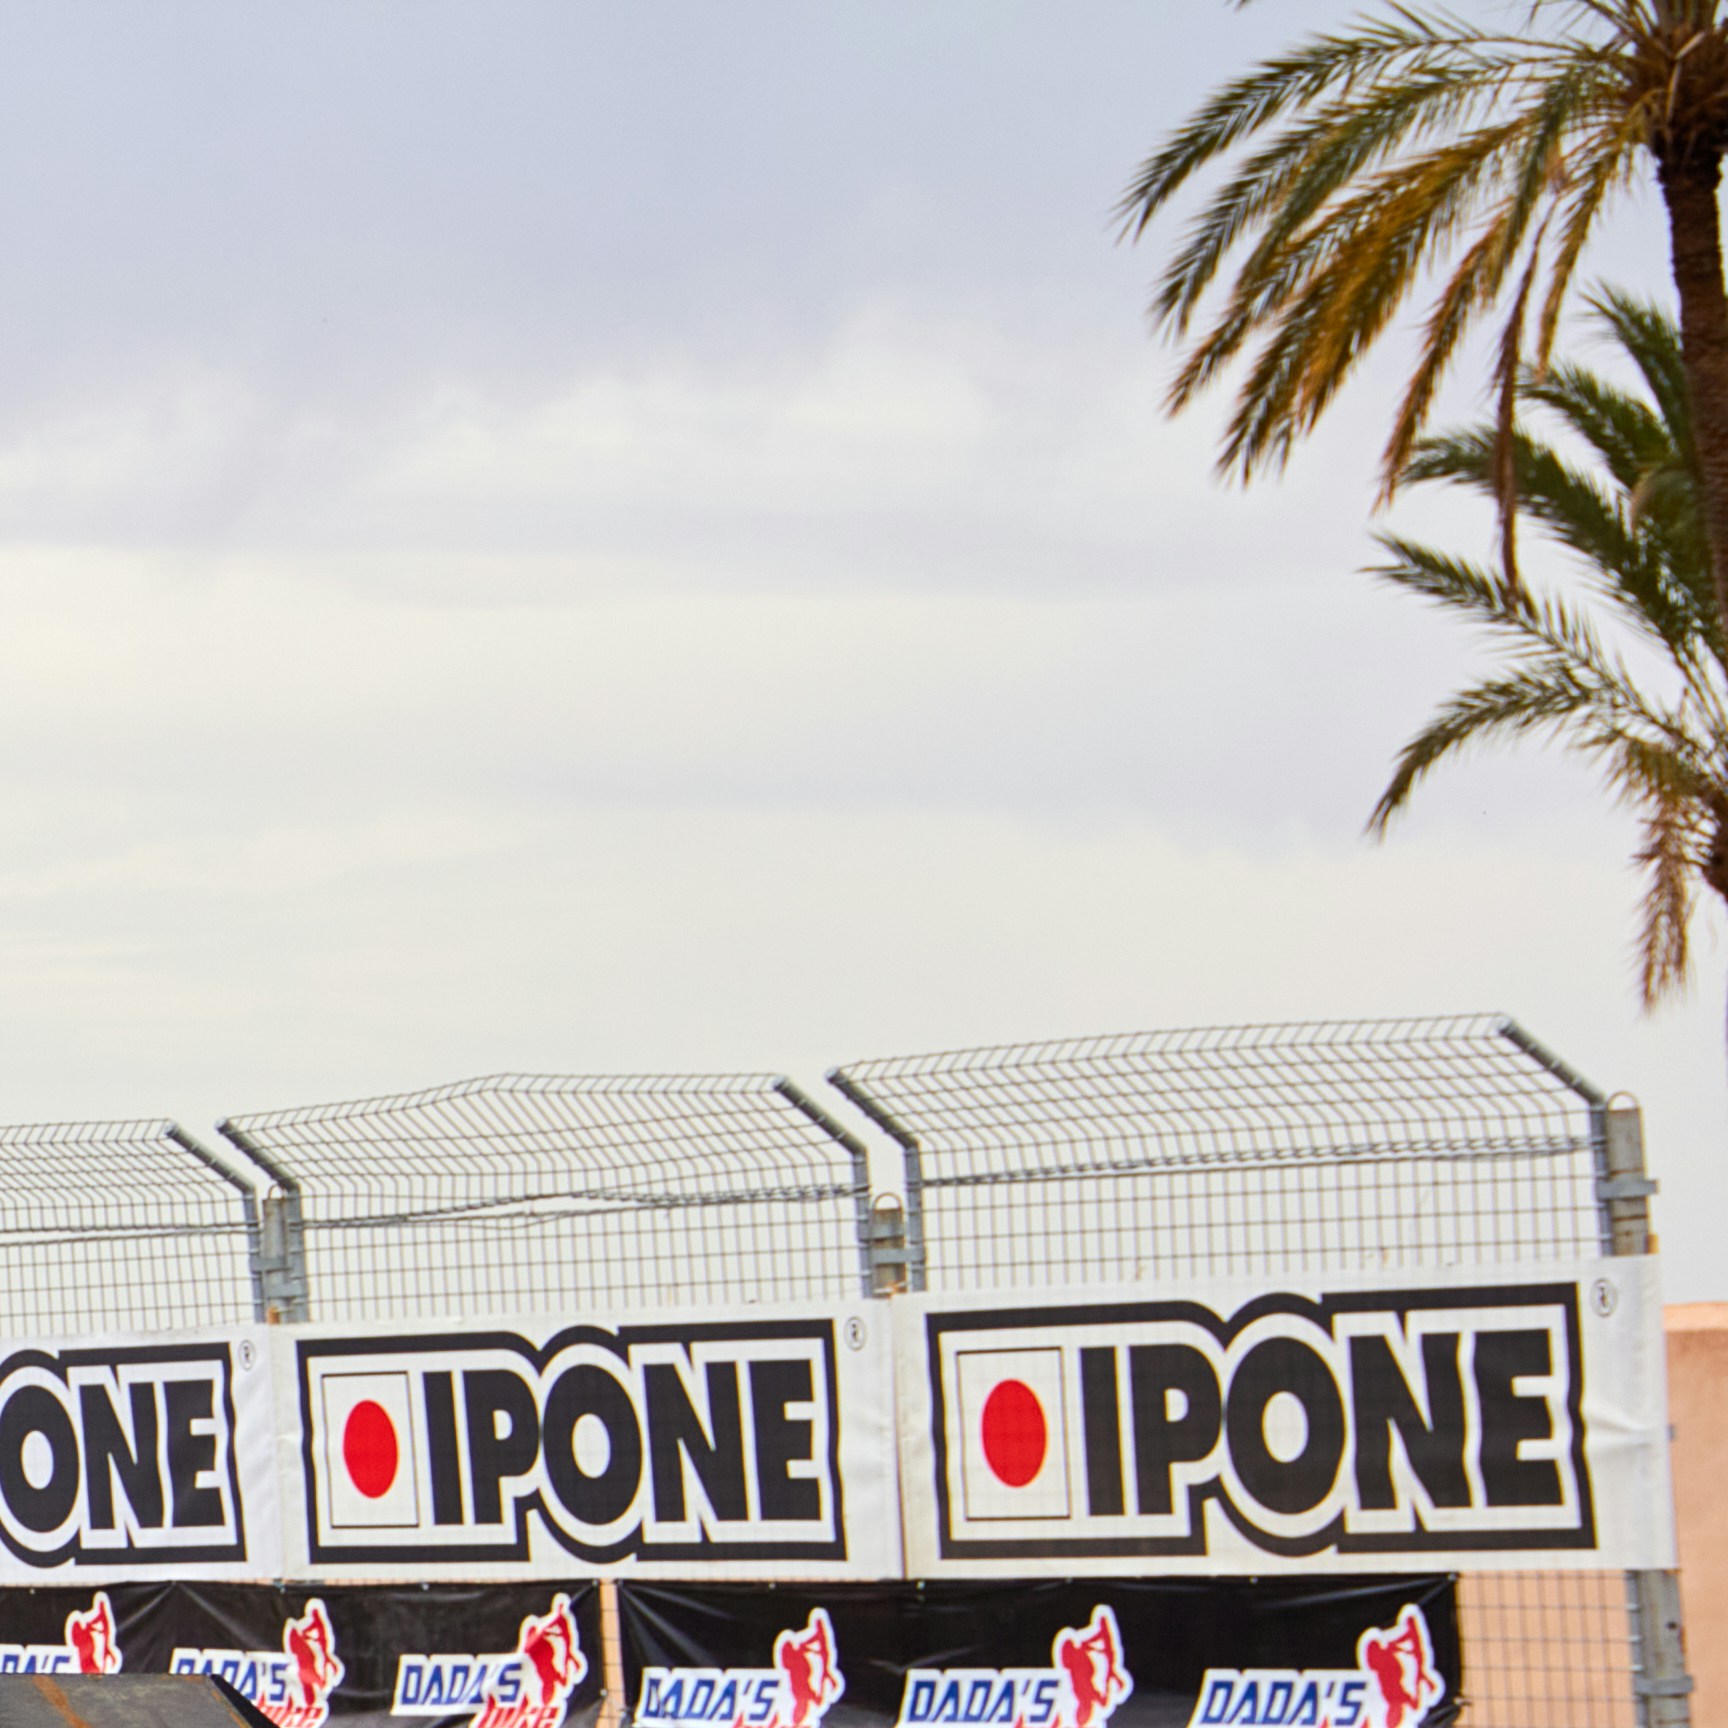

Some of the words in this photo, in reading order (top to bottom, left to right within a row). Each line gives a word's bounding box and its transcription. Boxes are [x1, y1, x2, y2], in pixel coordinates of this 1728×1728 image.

[421, 1357, 820, 1526] IPONE
[1079, 1327, 1565, 1517] IPONE
[643, 1677, 780, 1721] DADA'S
[907, 1679, 1060, 1723] DADA'S
[1199, 1680, 1367, 1726] DADA'S
